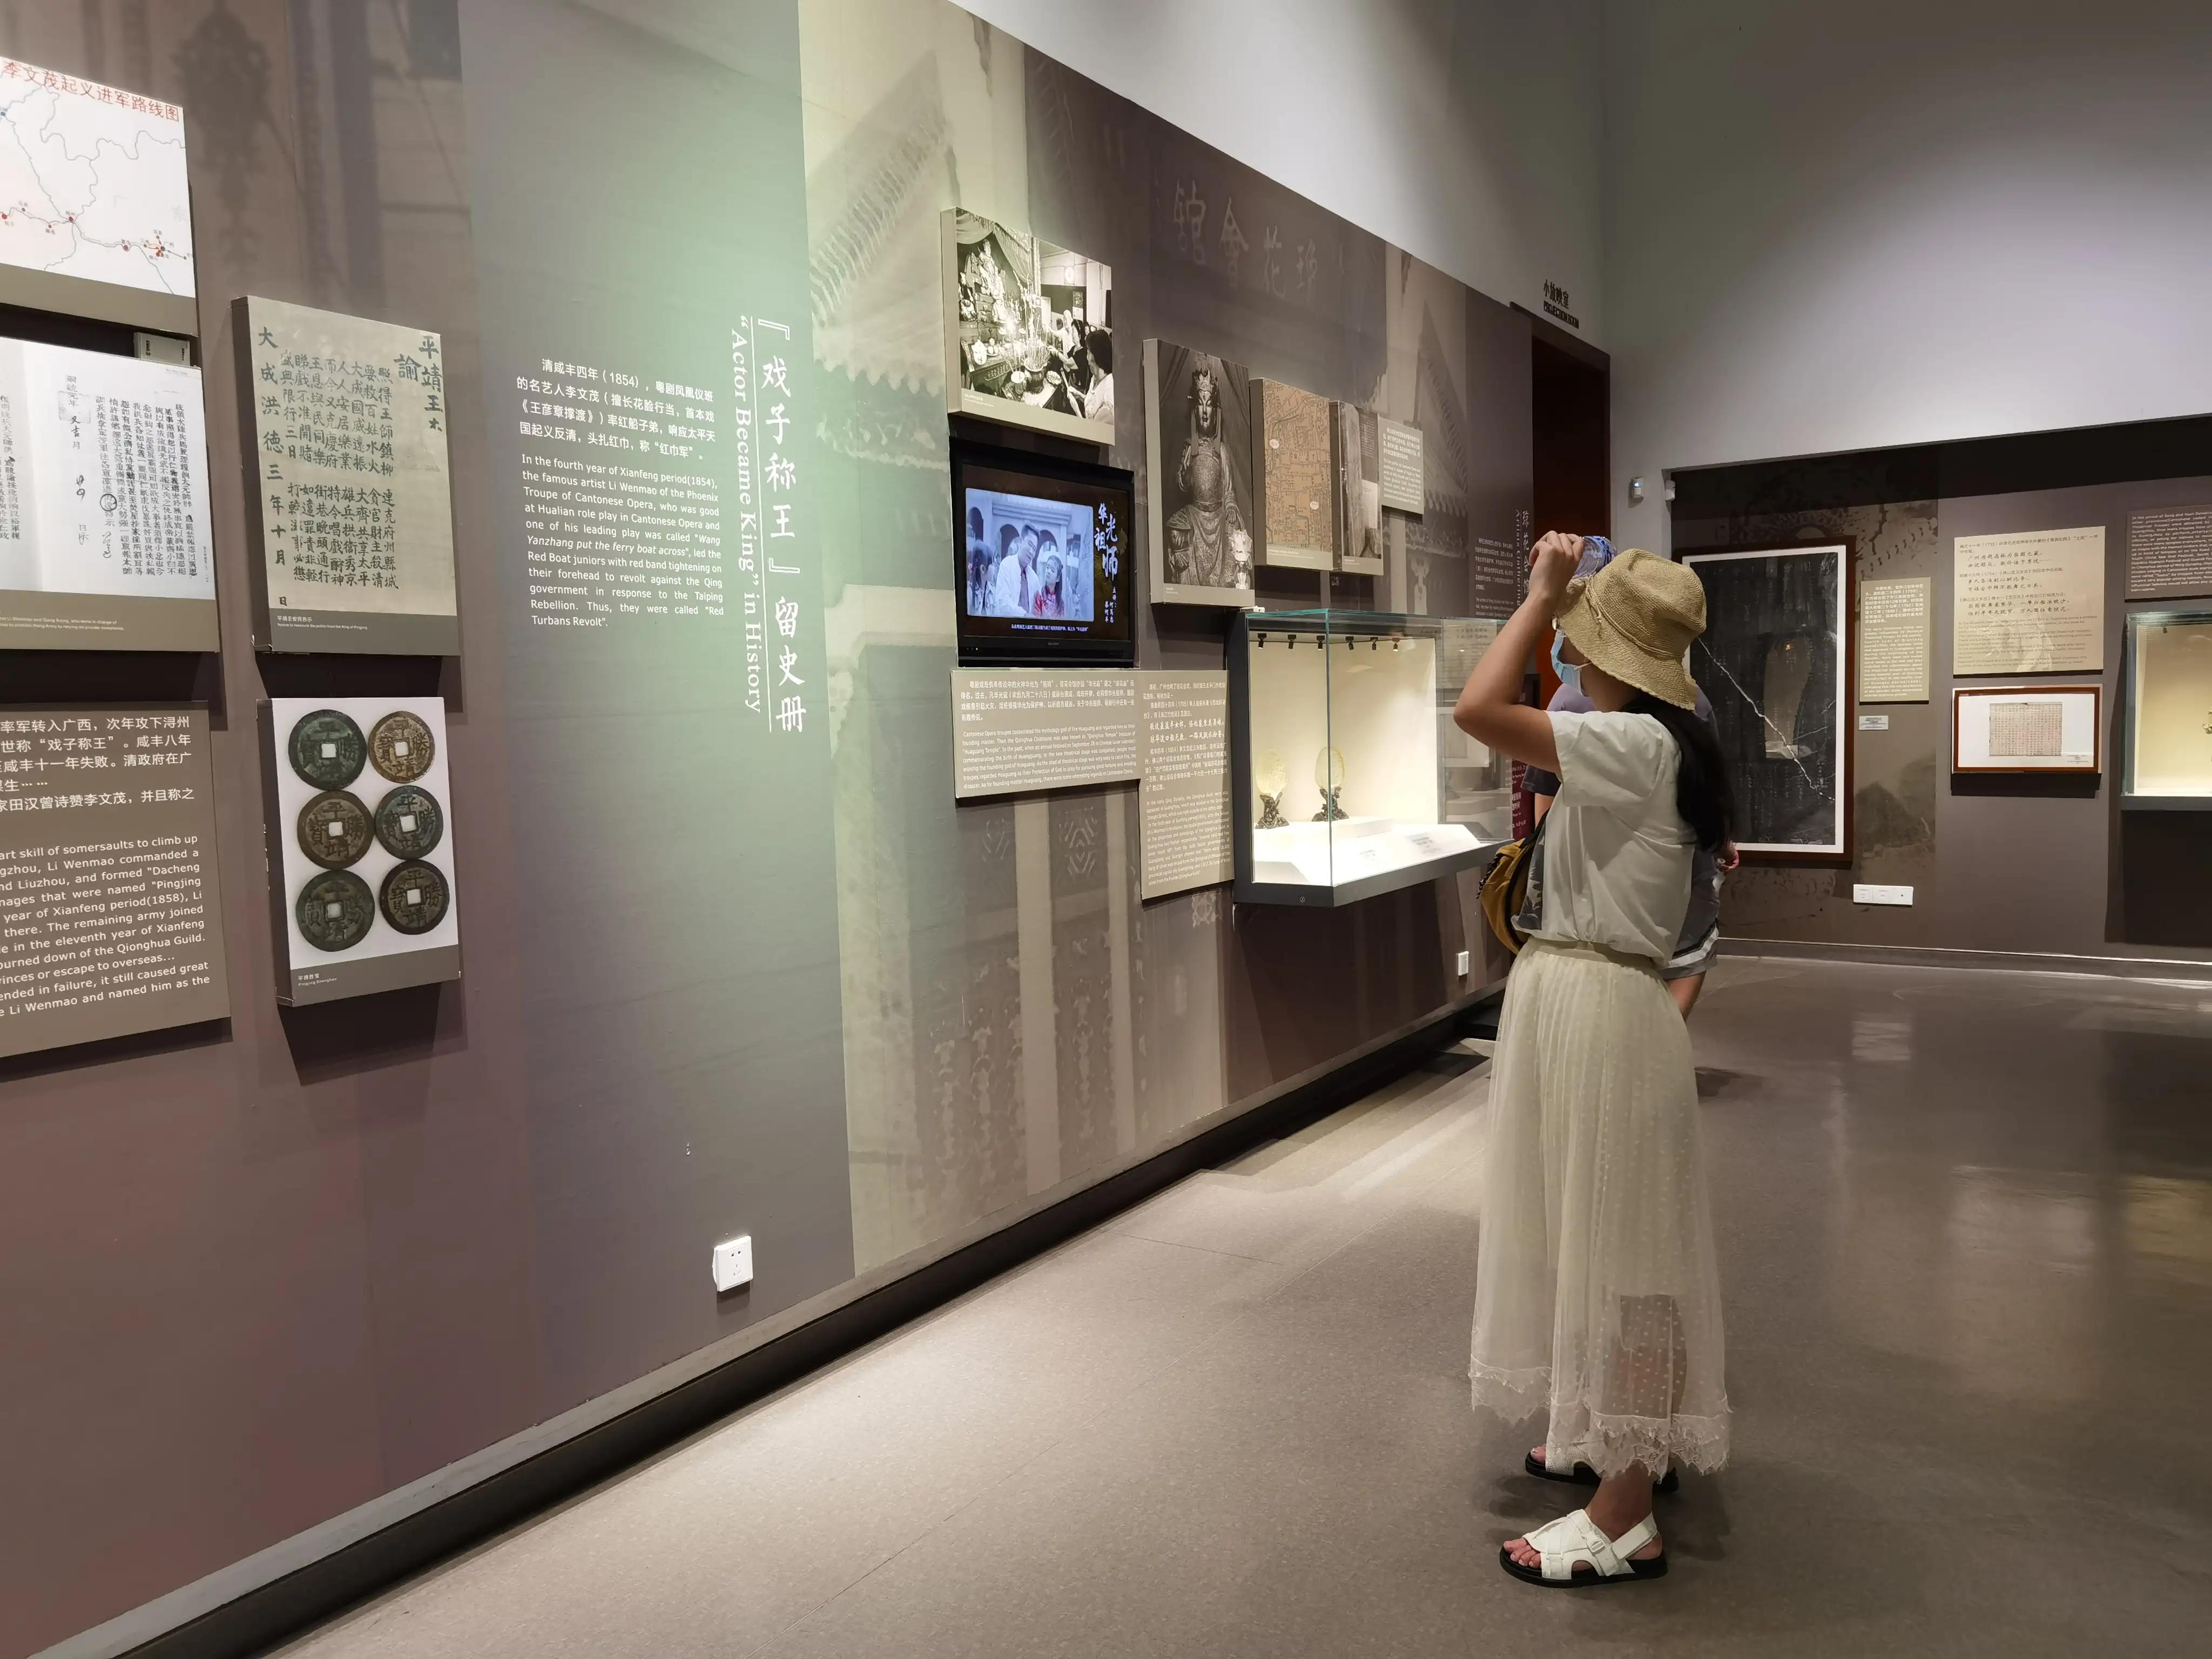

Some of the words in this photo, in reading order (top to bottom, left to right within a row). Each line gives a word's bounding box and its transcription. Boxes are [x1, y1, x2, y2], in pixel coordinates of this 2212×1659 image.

[3, 61, 179, 122] 李文茂起义进军路线图
[336, 360, 352, 471] 人人安居樂業
[521, 454, 532, 464] In
[535, 455, 551, 467] the
[553, 457, 584, 471] fourth
[585, 464, 607, 474] year
[609, 466, 618, 476] of
[619, 467, 658, 483] Xianfeng
[736, 406, 752, 505] Became
[522, 470, 539, 481] the
[542, 472, 578, 486] famous
[581, 478, 606, 489] artist
[609, 481, 617, 490] Li
[619, 482, 657, 495] Wenmao
[659, 487, 669, 496] of
[670, 488, 685, 498] the
[687, 490, 719, 502] Phoenix
[523, 486, 558, 501] Troupe
[562, 491, 572, 501] of
[575, 492, 624, 507] Cantonese
[627, 498, 656, 511] Opera,
[659, 502, 678, 512] who
[680, 505, 697, 514] was
[699, 507, 719, 517] good
[524, 503, 536, 513] at
[537, 504, 575, 517] Hualian
[577, 509, 596, 519] role
[598, 510, 618, 523] play
[620, 512, 629, 522] in
[631, 514, 677, 527] Cantonese
[678, 518, 703, 530] Opera
[705, 521, 720, 530] and
[525, 520, 544, 530] one
[549, 521, 560, 531] of
[564, 522, 579, 533] his
[583, 524, 617, 538] leading
[622, 527, 640, 540] play
[644, 531, 662, 540] was
[665, 532, 690, 542] called
[757, 318, 806, 732] 『戏子称王』留史册
[527, 535, 574, 550] Yanzhang
[576, 540, 593, 550] put
[595, 541, 610, 551] the
[612, 542, 635, 555] ferry
[637, 543, 657, 554] boat
[693, 548, 706, 558] led
[708, 549, 721, 559] the
[744, 592, 760, 615] in
[745, 622, 763, 713] History
[0, 752, 192, 772] 咸丰十一年失败。清政府在广
[19, 847, 44, 859] skill
[47, 846, 60, 856] of
[63, 840, 134, 854] somersaults
[137, 839, 149, 848] to
[151, 835, 181, 847] climb
[184, 835, 198, 845] up
[3, 912, 32, 924] year
[36, 907, 49, 919] of
[52, 903, 105, 916] Xianfeng
[193, 890, 203, 900] Li
[41, 891, 67, 902] that
[72, 889, 102, 899] were
[107, 882, 146, 895] named
[4, 927, 42, 938] there.
[46, 922, 70, 932] The
[74, 915, 133, 929] remaining
[136, 911, 166, 921] army
[169, 904, 204, 919] joined
[39, 985, 50, 995] in
[53, 980, 97, 993] failure,
[100, 976, 110, 985] it
[112, 972, 134, 983] still
[136, 965, 177, 980] caused
[179, 961, 210, 975] great
